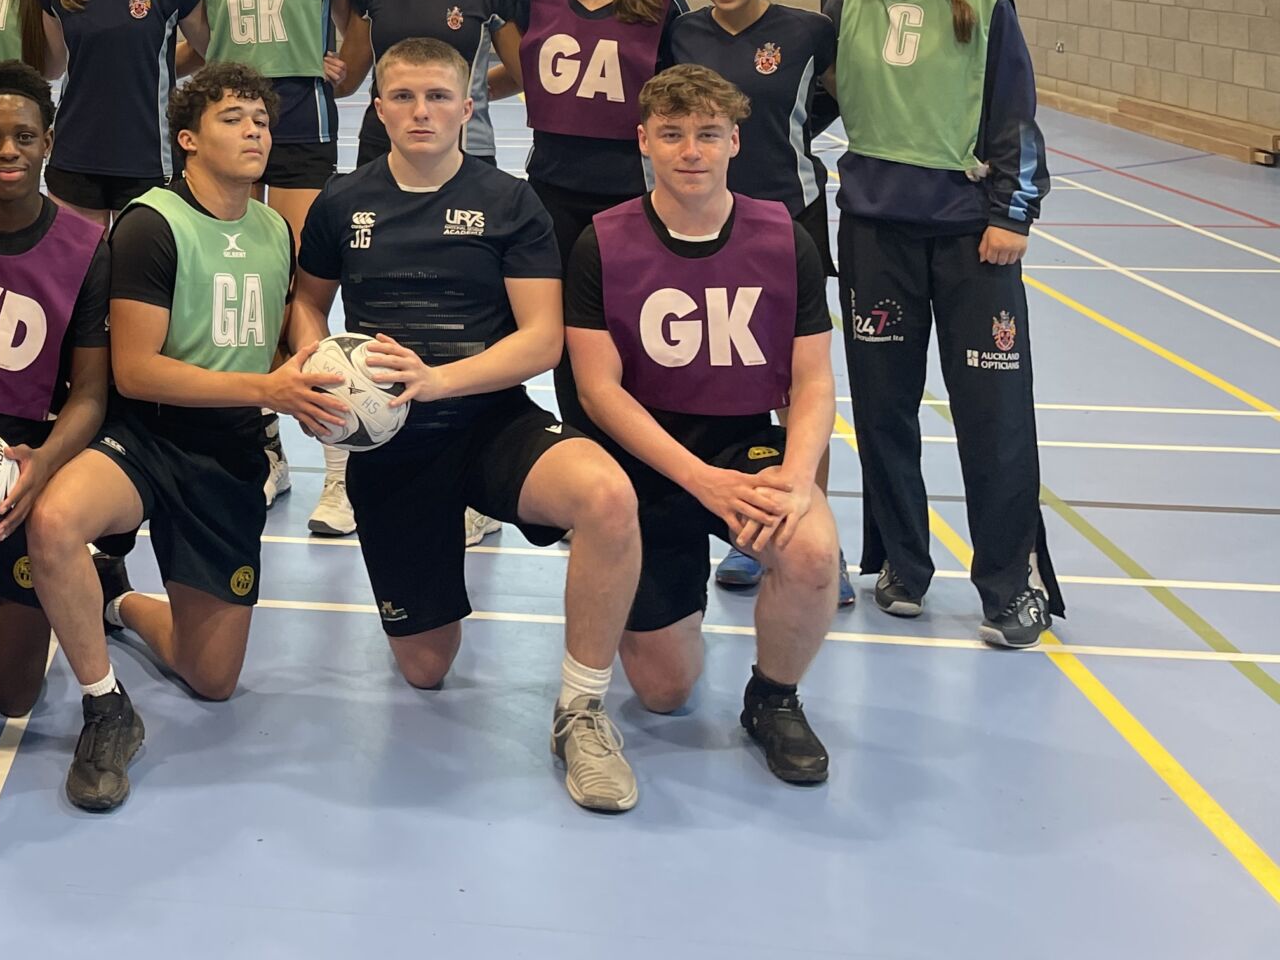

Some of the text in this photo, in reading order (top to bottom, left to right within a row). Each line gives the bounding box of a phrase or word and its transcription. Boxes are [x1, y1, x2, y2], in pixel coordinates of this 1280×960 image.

[882, 2, 925, 67] C
[538, 33, 626, 103] GA
[350, 228, 372, 249] JG
[212, 272, 266, 348] GA
[639, 286, 768, 368] GK
[980, 360, 1020, 370] OPTICIANS
[981, 351, 1020, 361] AUCKLAND
